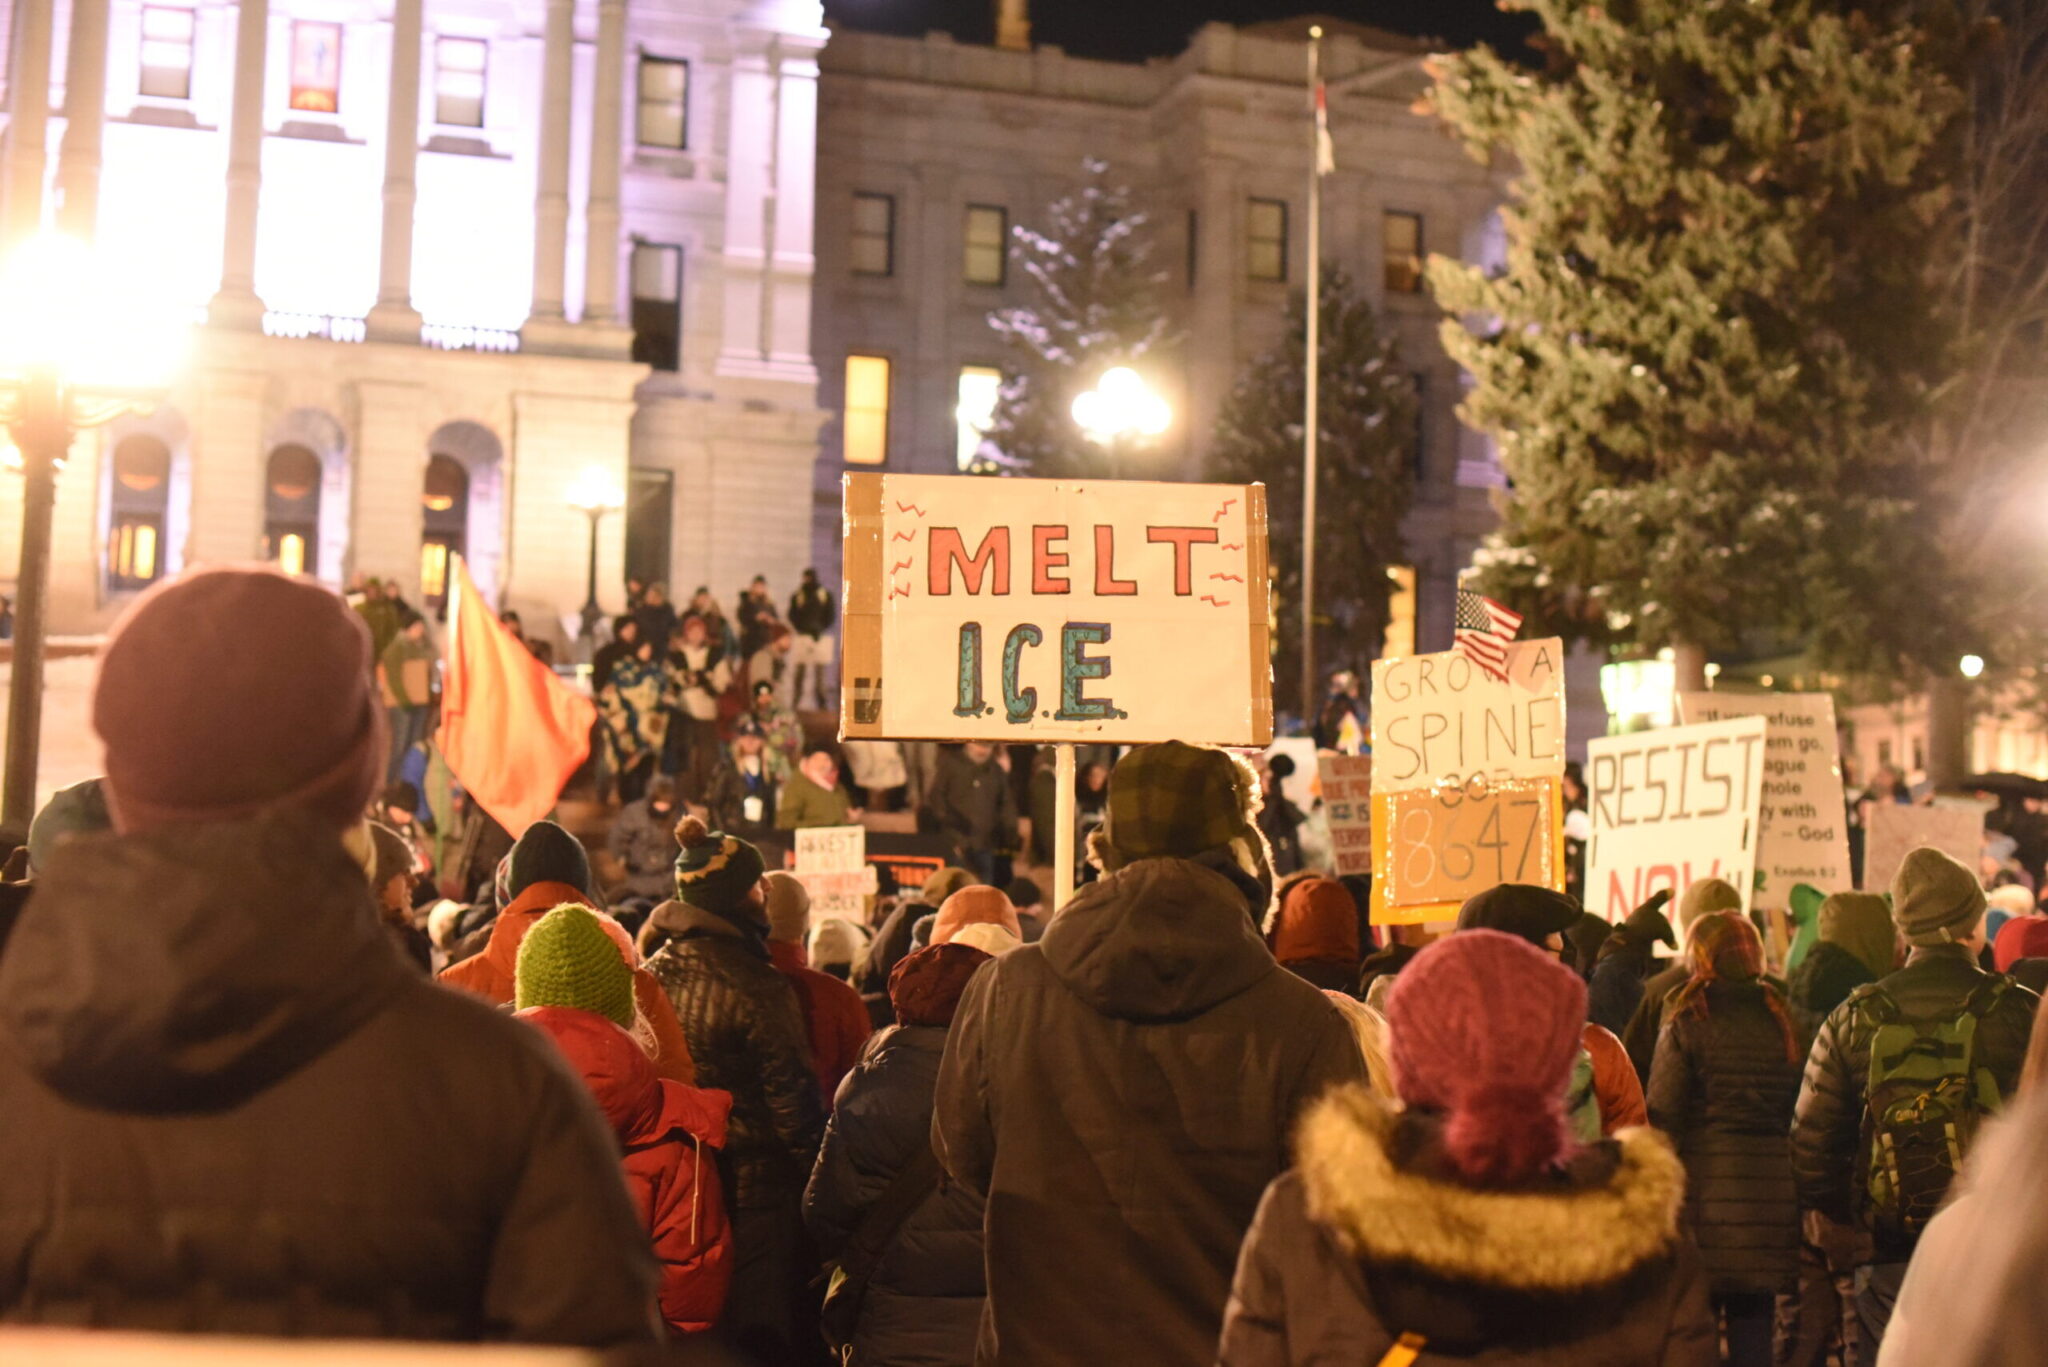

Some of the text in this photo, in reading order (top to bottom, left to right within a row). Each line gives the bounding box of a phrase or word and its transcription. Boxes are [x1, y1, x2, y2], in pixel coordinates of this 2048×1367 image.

[928, 524, 1219, 597] MELT
[1529, 645, 1553, 678] A
[1767, 711, 1815, 726] efuse
[1386, 697, 1556, 780] SPINE
[1593, 733, 1762, 830] RESIST
[1762, 780, 1802, 794] hole
[1781, 803, 1817, 818] with
[1402, 800, 1541, 888] 8647
[1798, 826, 1834, 841] God
